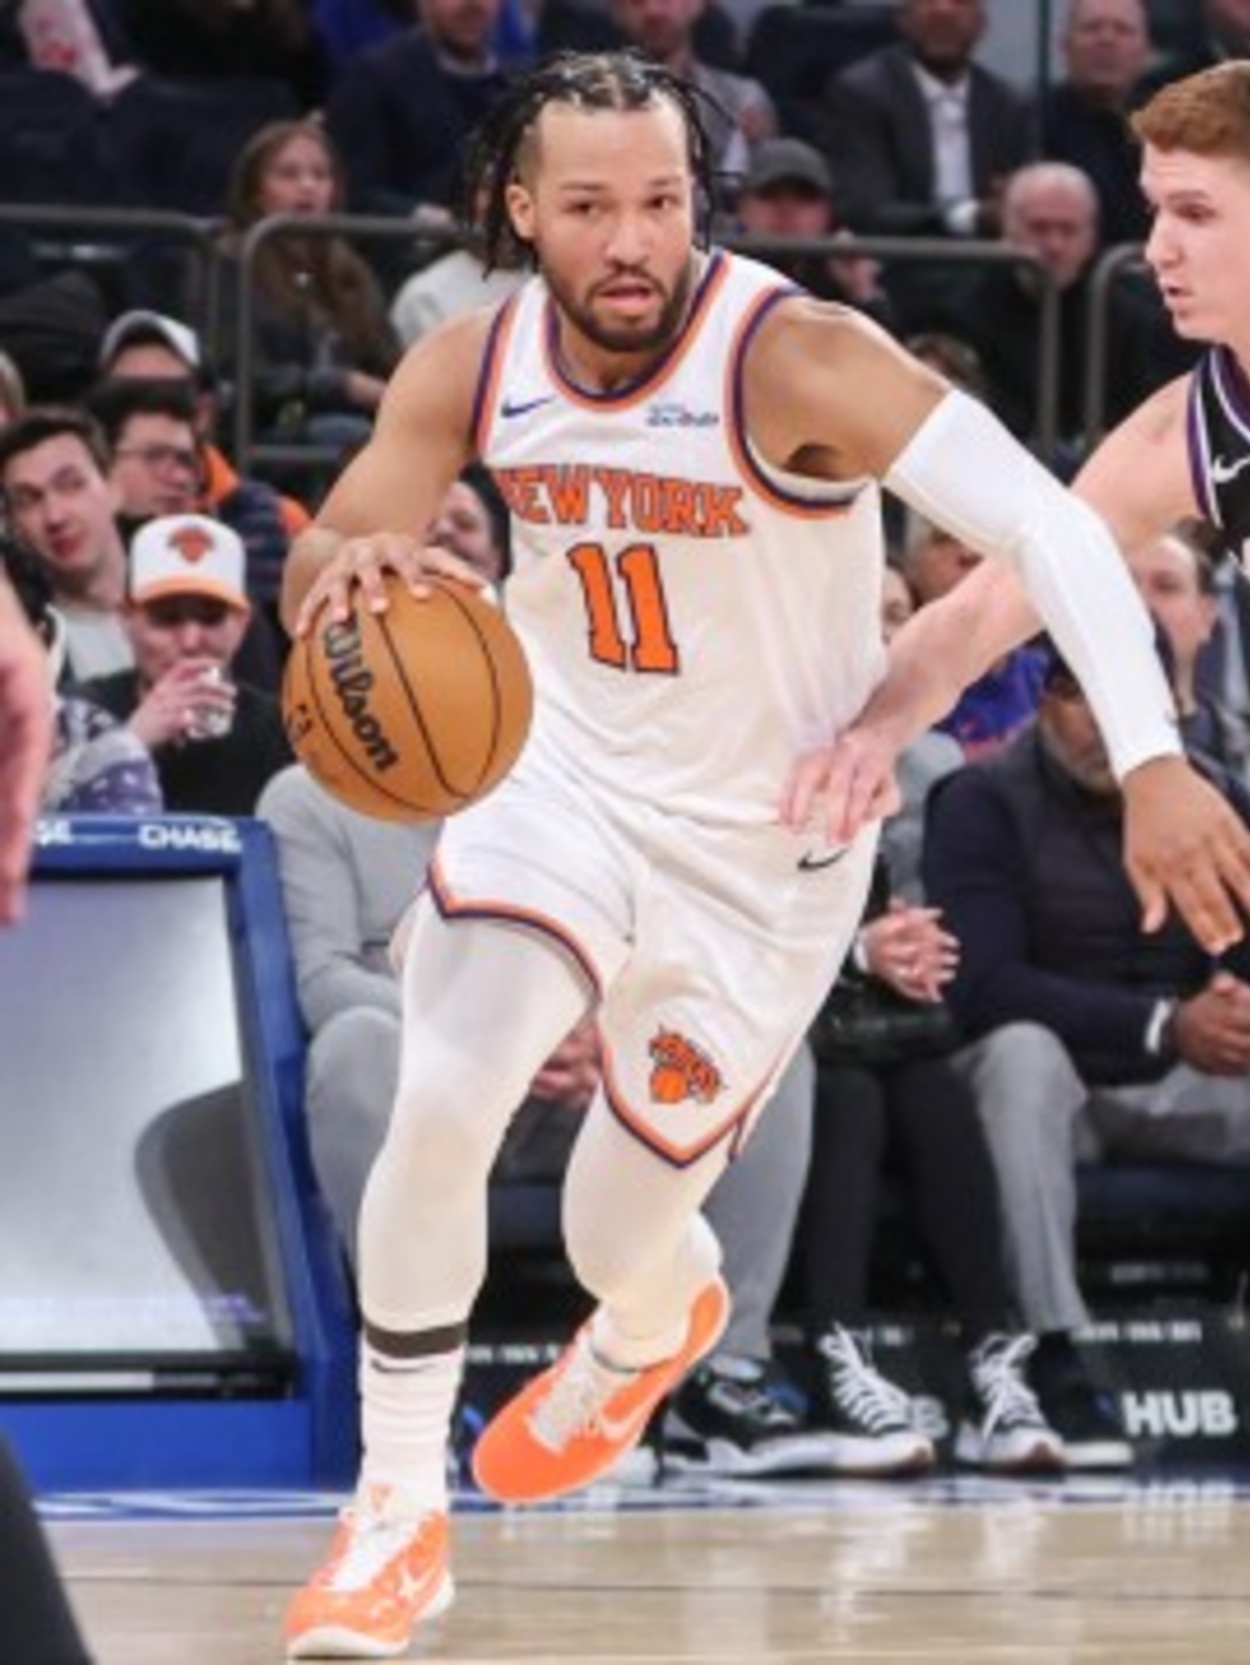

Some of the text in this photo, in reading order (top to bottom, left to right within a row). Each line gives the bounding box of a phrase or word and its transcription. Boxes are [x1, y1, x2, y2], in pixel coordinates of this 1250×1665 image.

[594, 465, 750, 538] YORK
[566, 541, 679, 676] 11
[324, 608, 399, 774] Wilson
[138, 823, 243, 854] CHASE
[1122, 1390, 1238, 1437] HUB
